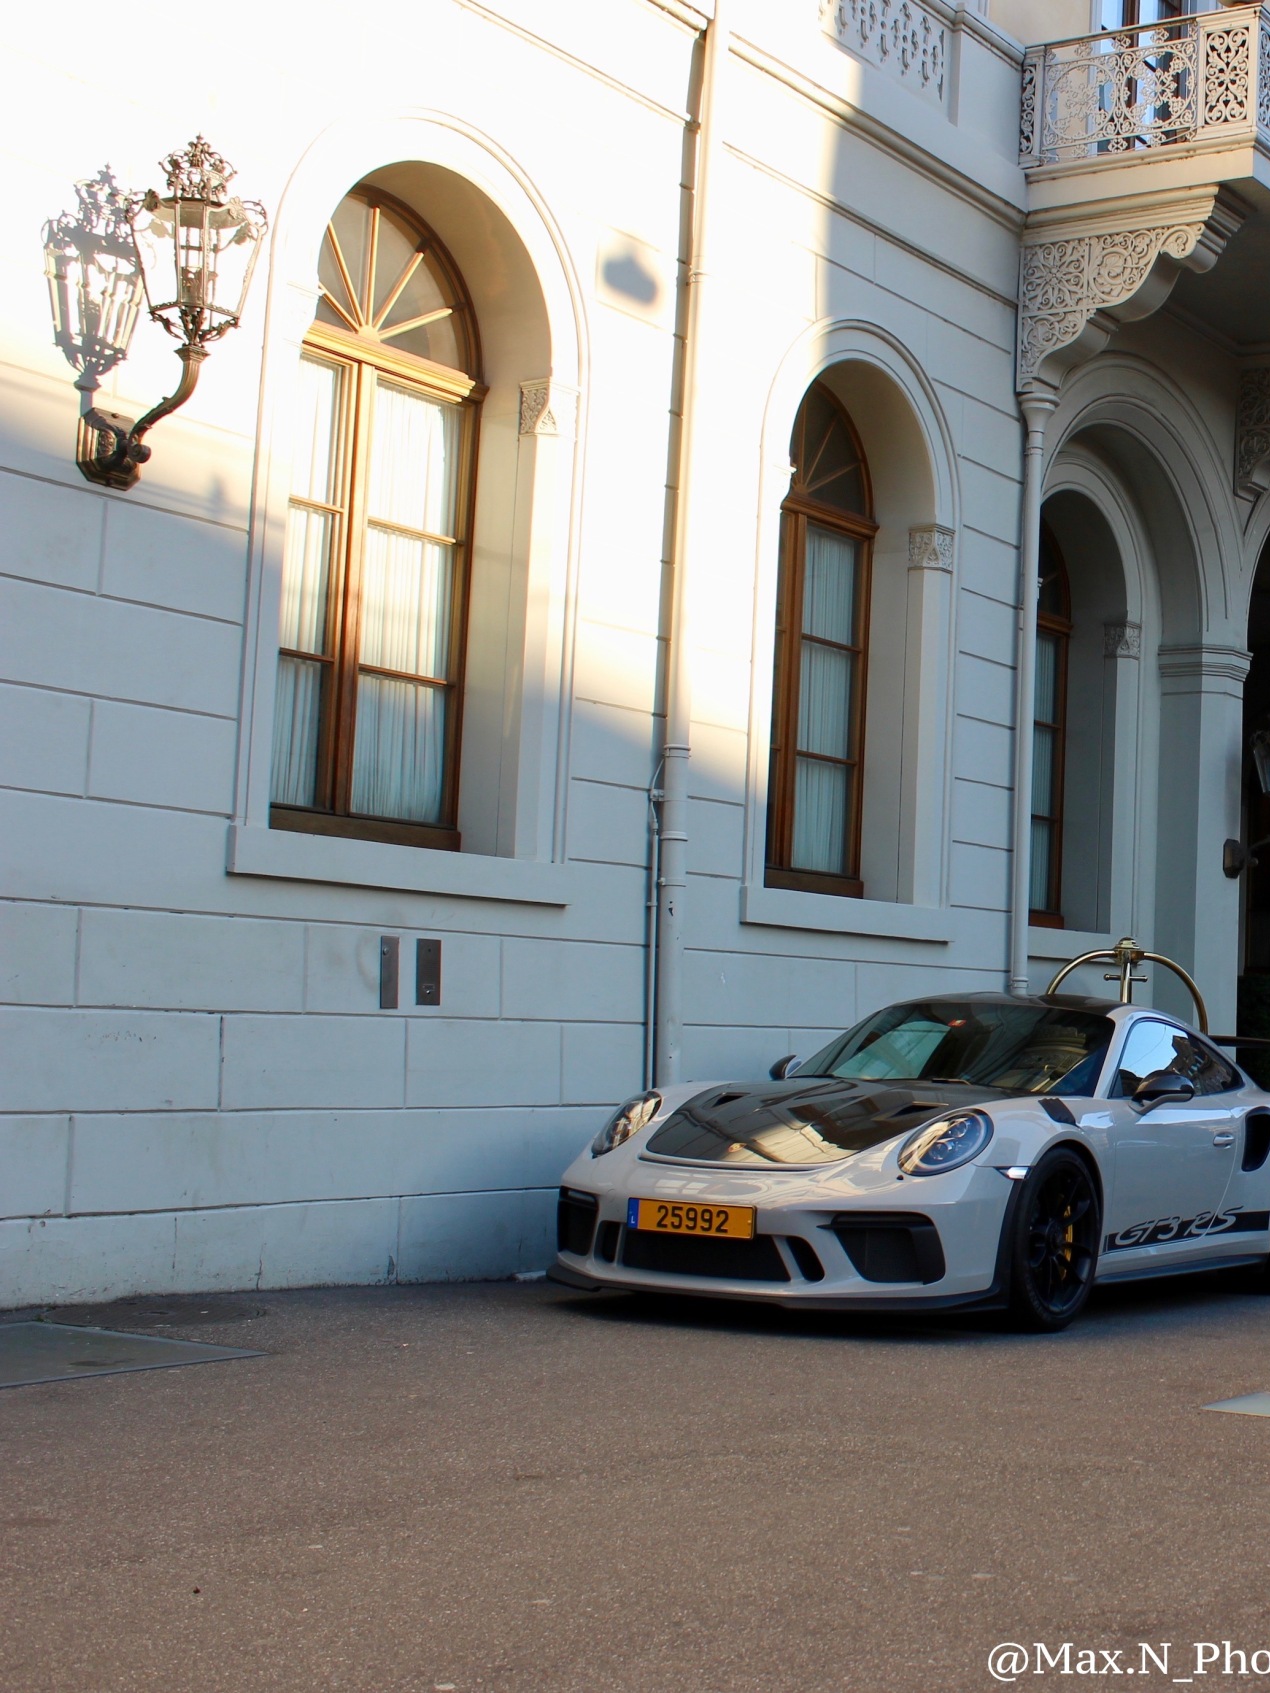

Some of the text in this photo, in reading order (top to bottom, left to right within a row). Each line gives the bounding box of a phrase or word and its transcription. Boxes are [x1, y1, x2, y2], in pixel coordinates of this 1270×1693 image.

[656, 1204, 730, 1234] 25992
[1114, 1205, 1244, 1246] GT3 RS
